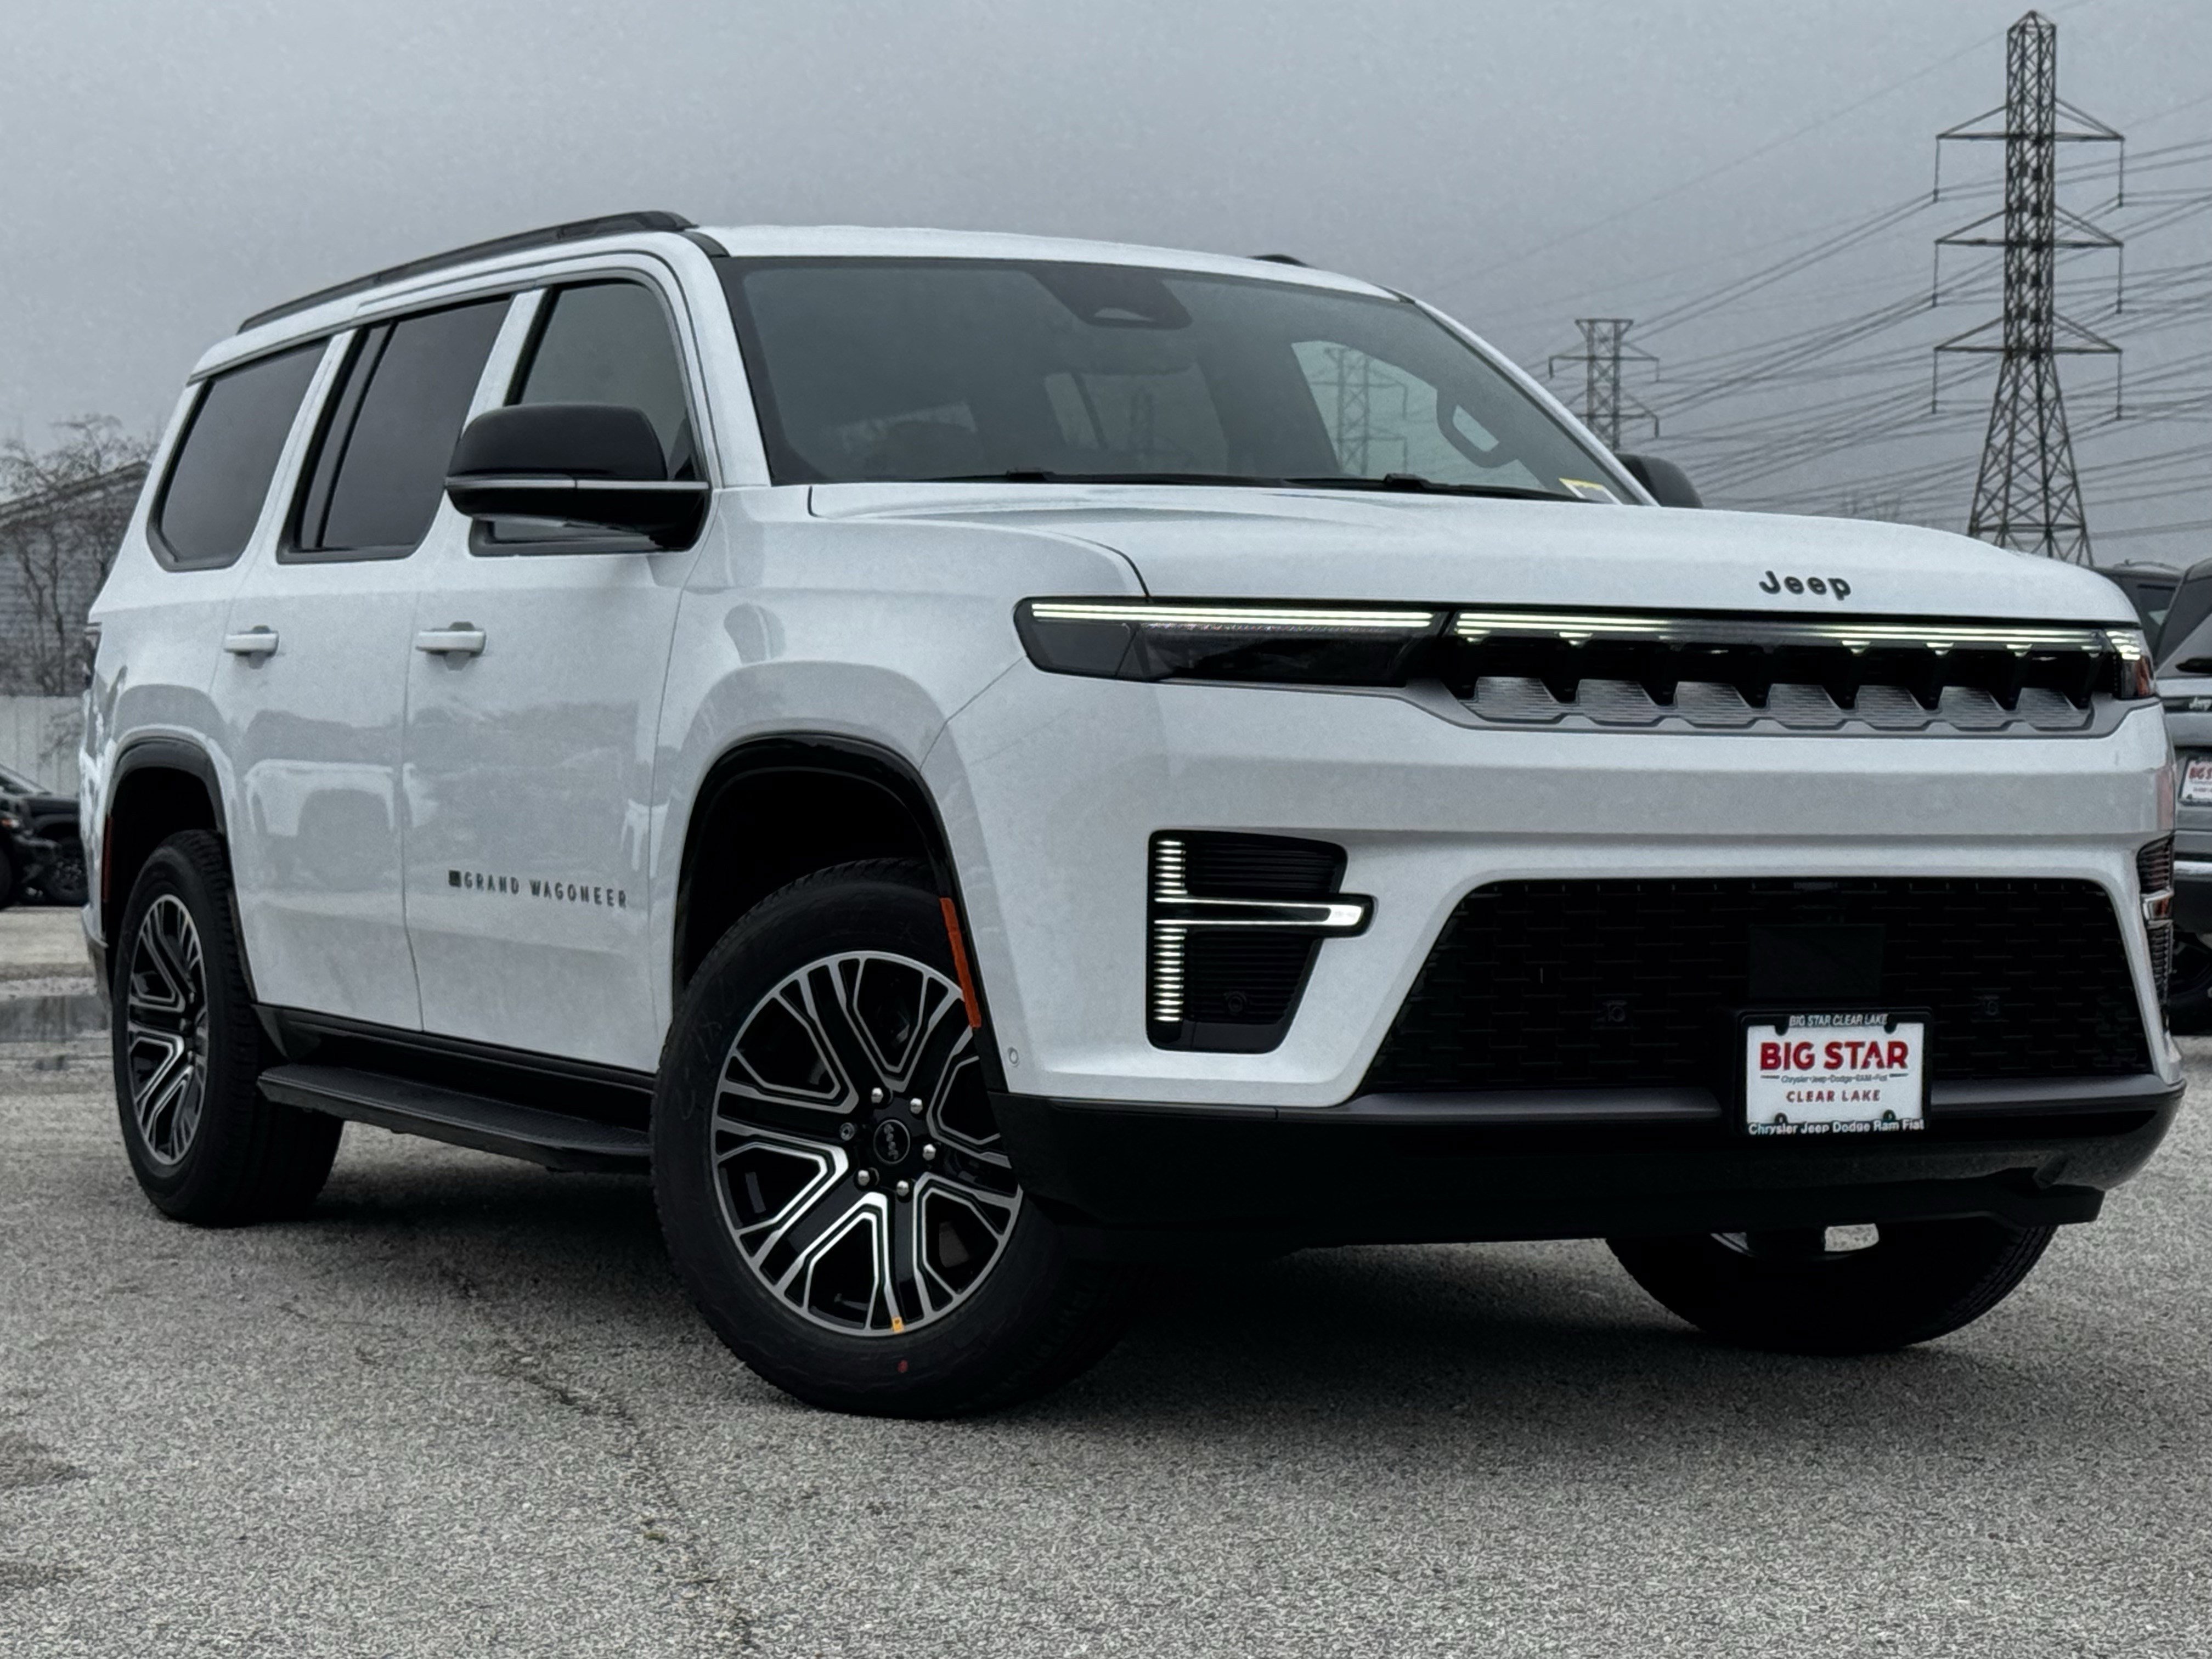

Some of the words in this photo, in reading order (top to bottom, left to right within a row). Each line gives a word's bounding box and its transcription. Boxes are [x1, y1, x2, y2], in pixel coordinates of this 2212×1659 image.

[1759, 571, 1851, 601] Jeep
[464, 871, 520, 895] GRAND
[529, 879, 627, 909] WAGONEER
[1789, 1015, 1805, 1026] BIG
[1808, 1015, 1831, 1026] STAR
[1832, 1014, 1863, 1026] CLEAR
[1864, 1013, 1888, 1025] LAKE
[1760, 1042, 1815, 1070] BIG
[1823, 1041, 1909, 1070] STAR
[1786, 1091, 1835, 1103] CLEAR
[1842, 1090, 1881, 1102] LAKE
[1748, 1122, 1797, 1136] Chrysler
[1800, 1121, 1830, 1135] Jeep
[1832, 1121, 1871, 1133] Dodge
[1874, 1119, 1900, 1132] Ram
[1902, 1119, 1925, 1131] Fiat
